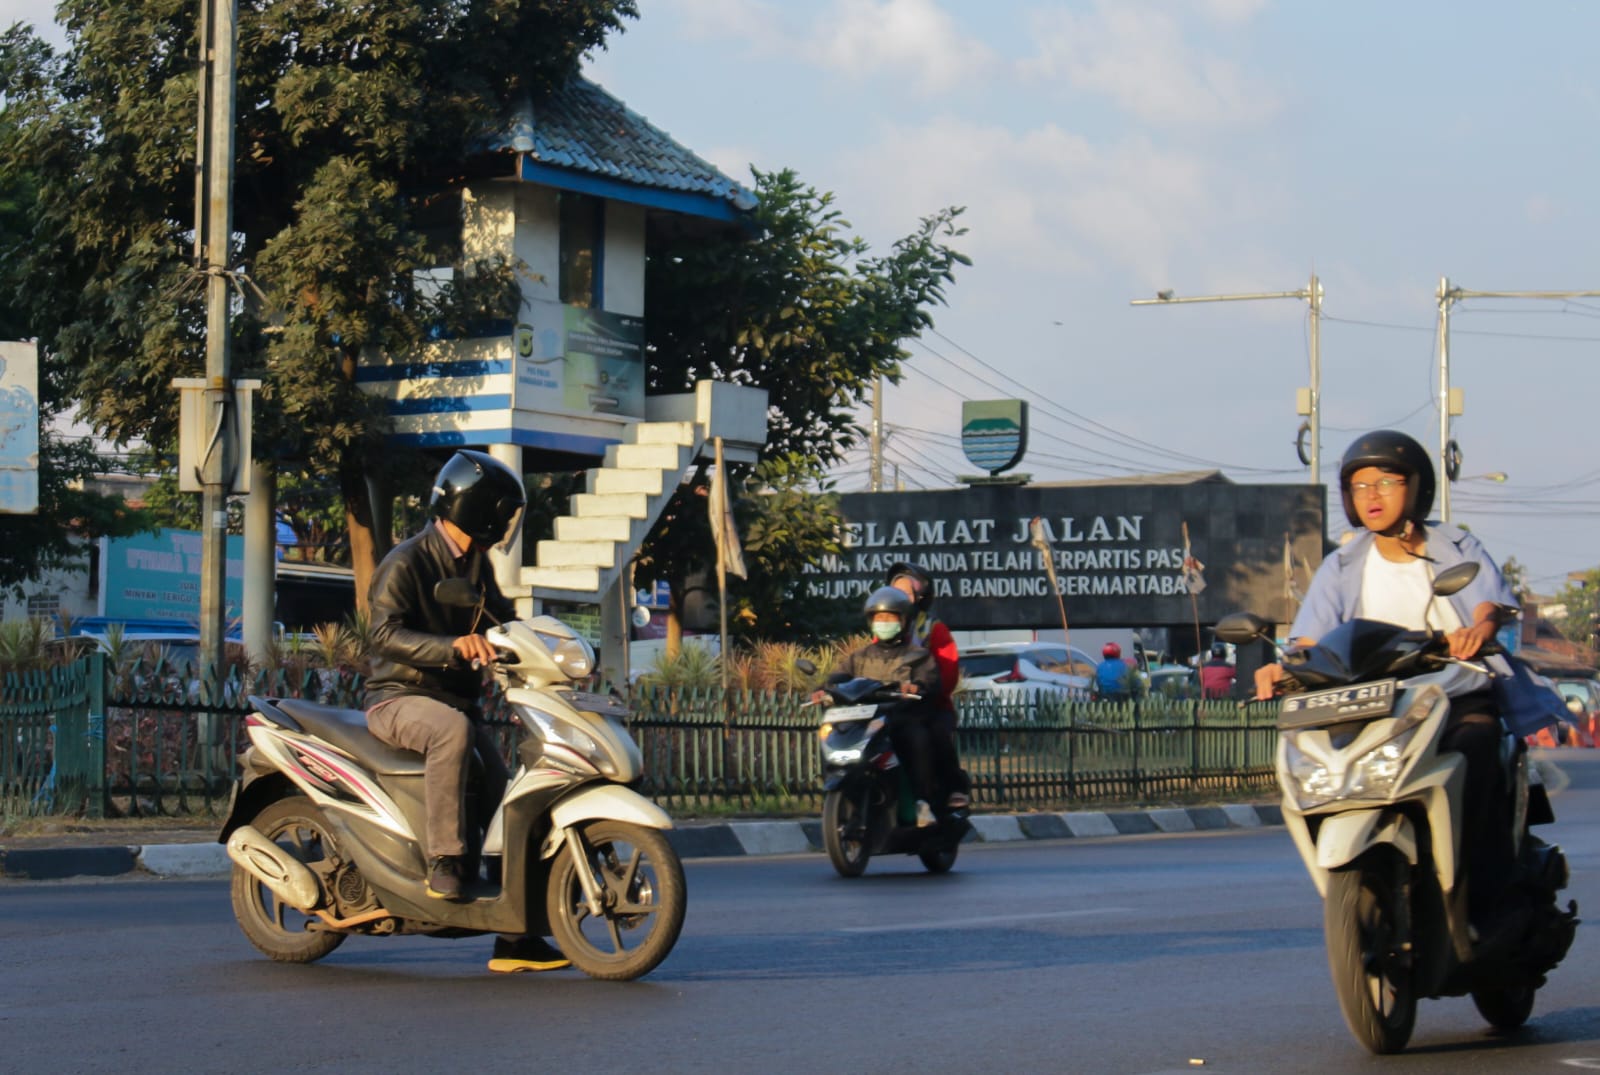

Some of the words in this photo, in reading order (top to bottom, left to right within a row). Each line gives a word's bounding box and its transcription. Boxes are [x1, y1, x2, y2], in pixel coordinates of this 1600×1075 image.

[918, 552, 968, 573] ANDA
[971, 551, 1032, 571] TELAH
[960, 576, 1049, 598] BANDUNG
[1055, 574, 1189, 596] BERMARTABA
